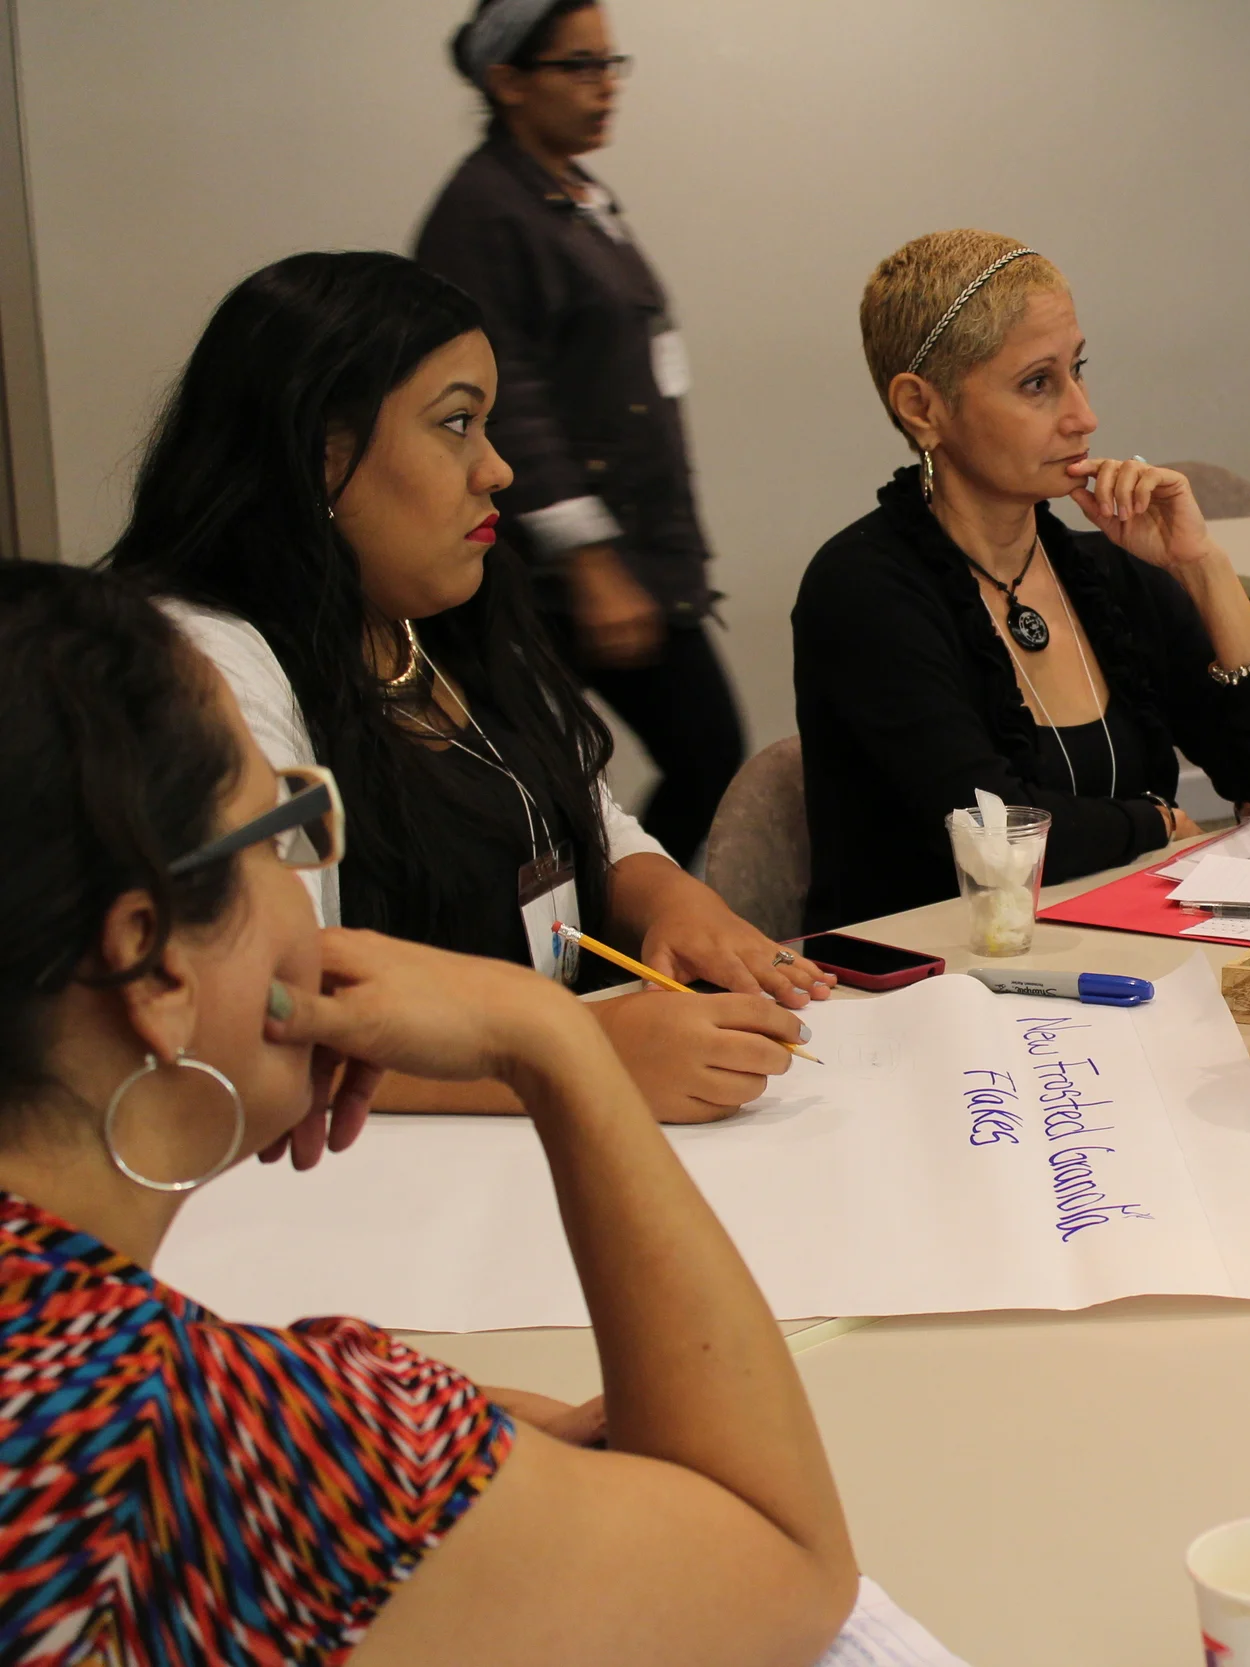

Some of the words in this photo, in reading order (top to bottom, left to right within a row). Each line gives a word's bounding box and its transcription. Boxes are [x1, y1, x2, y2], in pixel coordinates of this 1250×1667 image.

[1016, 1017, 1092, 1055] New
[963, 1069, 1024, 1146] Flakes
[1033, 1058, 1115, 1141] Frosted
[1048, 1146, 1141, 1243] Granola
